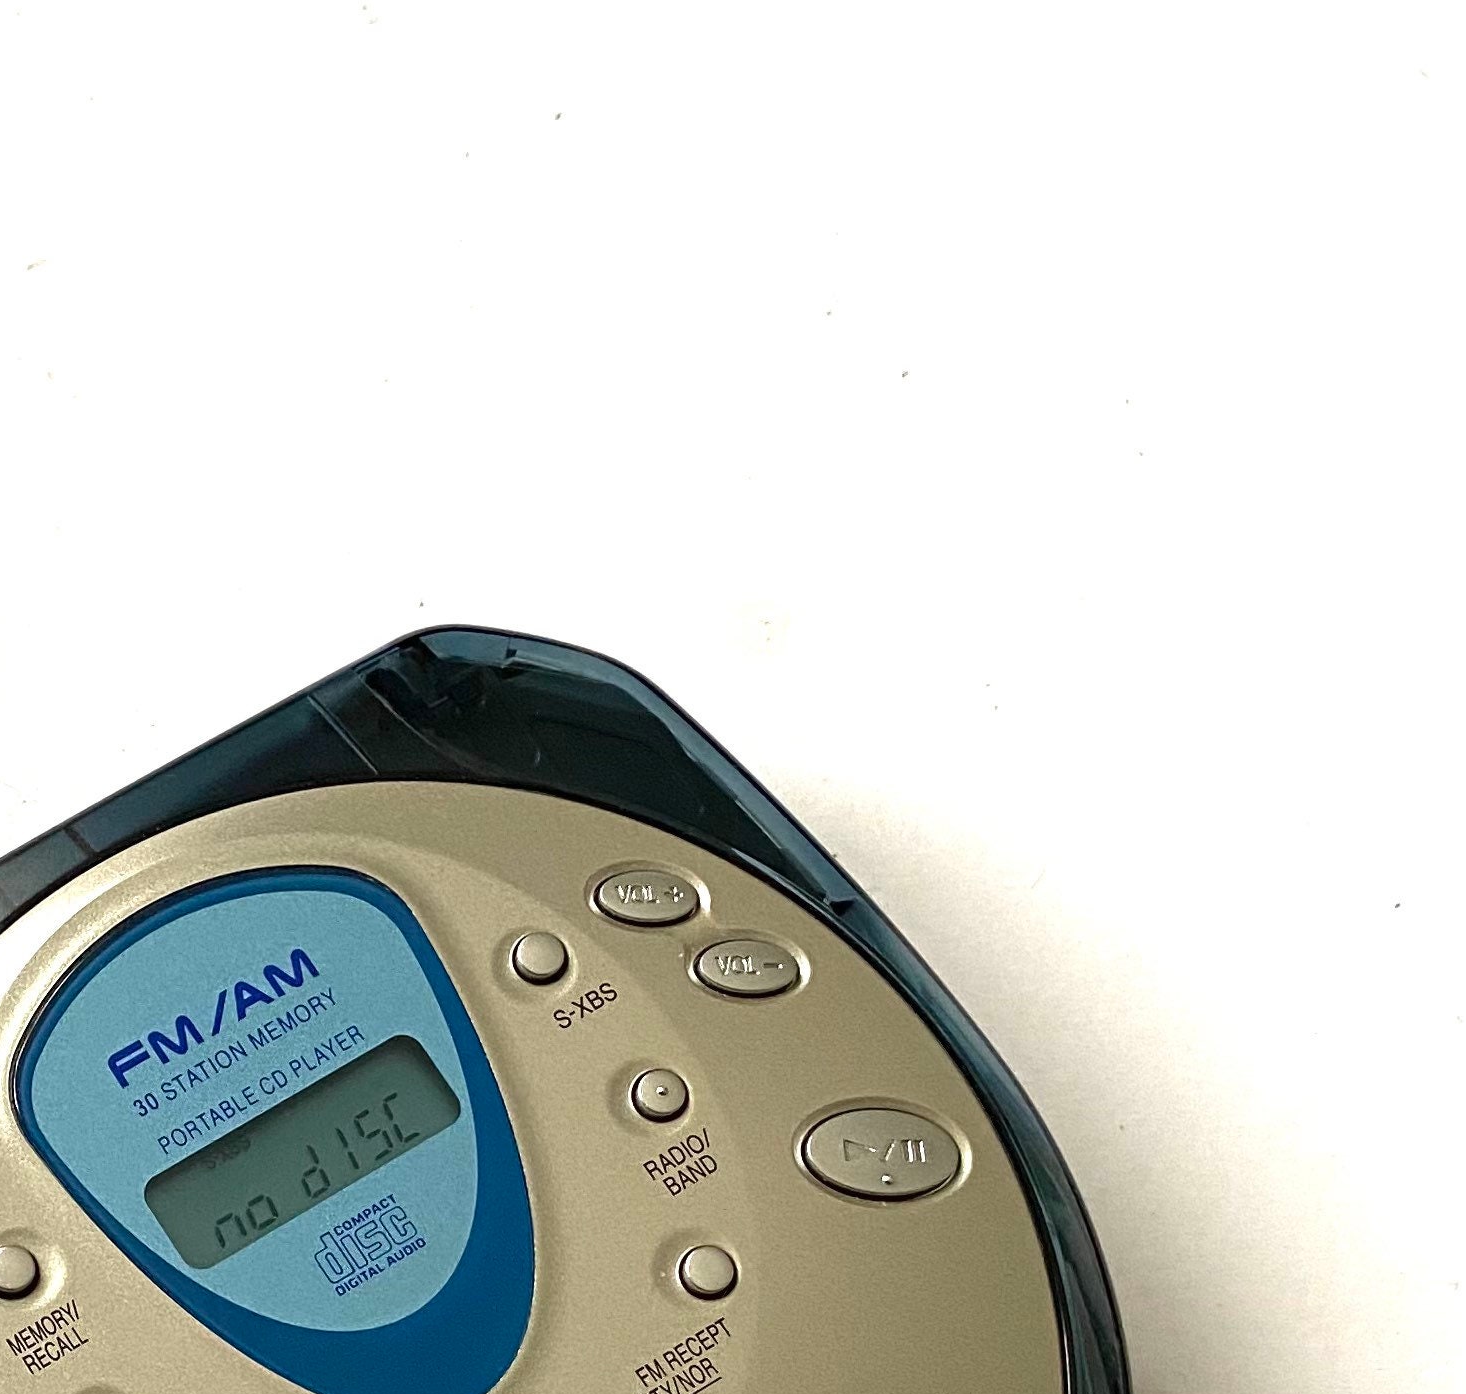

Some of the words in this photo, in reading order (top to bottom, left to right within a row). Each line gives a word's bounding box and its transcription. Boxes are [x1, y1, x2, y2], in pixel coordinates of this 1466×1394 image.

[615, 885, 660, 905] VOL
[714, 955, 761, 976] VOL
[107, 948, 320, 1089] FM/AM
[553, 982, 618, 1029] S-XBS
[134, 1092, 160, 1117] 30
[161, 1040, 248, 1101] STATION
[247, 988, 337, 1050] MEMORY
[157, 1087, 258, 1155] PORTABLE
[259, 1069, 288, 1095] CD
[289, 1025, 366, 1078] PLAYER
[643, 1128, 710, 1181] RADIO/
[663, 1154, 718, 1196] BAND
[215, 1195, 279, 1248] no
[334, 1194, 397, 1236] COMPACT
[314, 1205, 418, 1284] disc
[335, 1265, 385, 1297] DIGITAL
[388, 1238, 426, 1267] AUDIO
[6, 1299, 80, 1356] MEMORY/
[22, 1327, 90, 1375] RECALL
[635, 1358, 667, 1388] FM
[662, 1317, 731, 1371] RECEPT
